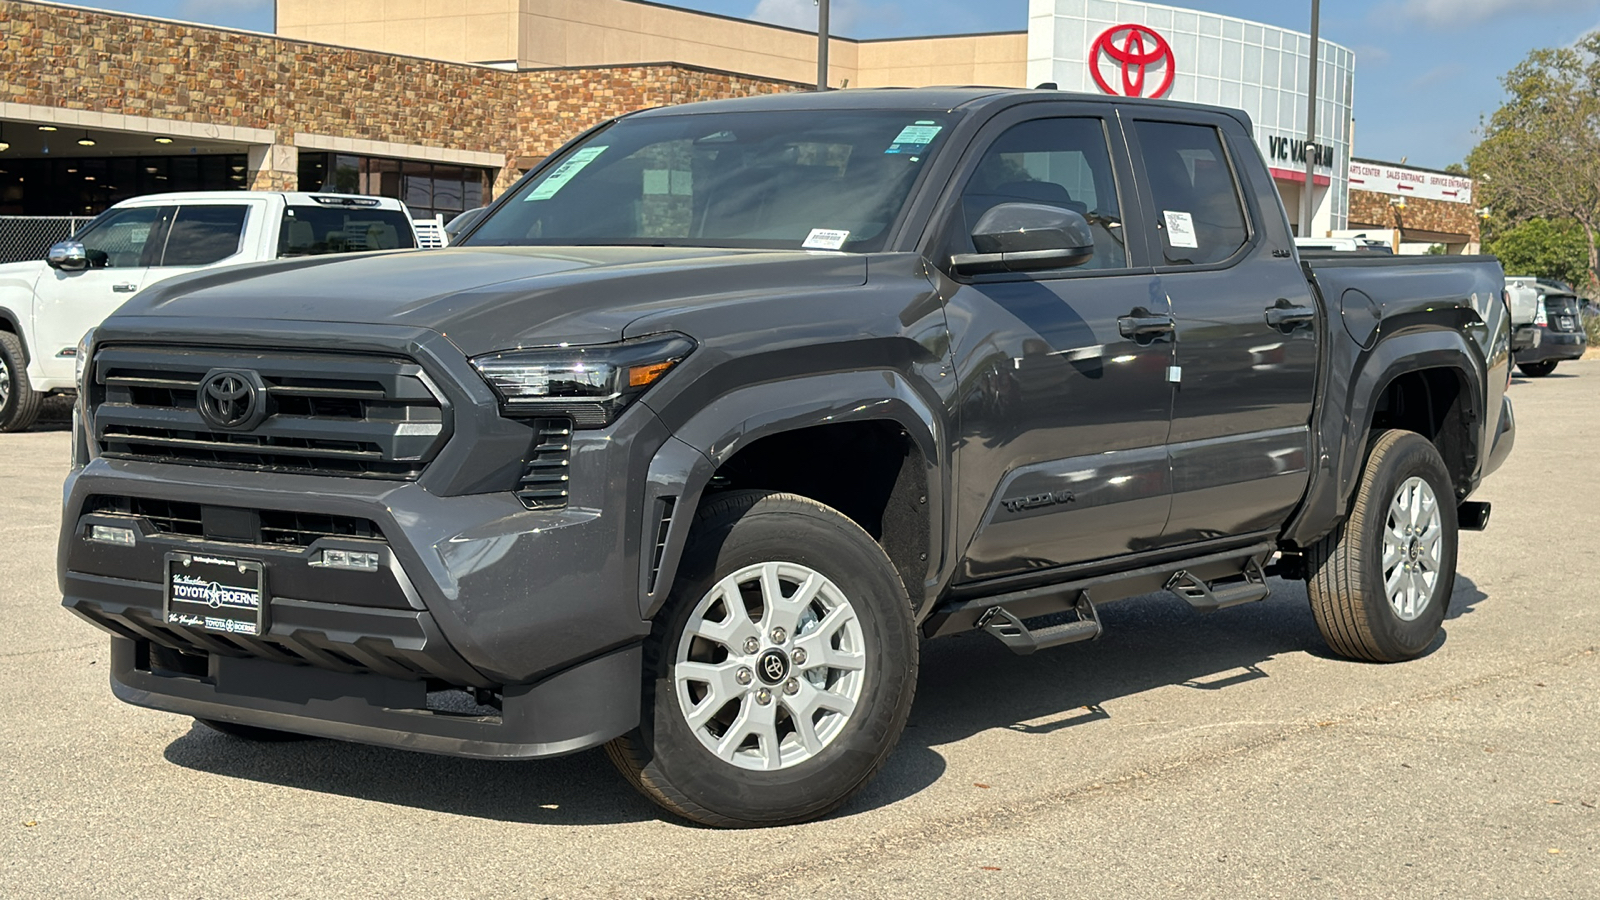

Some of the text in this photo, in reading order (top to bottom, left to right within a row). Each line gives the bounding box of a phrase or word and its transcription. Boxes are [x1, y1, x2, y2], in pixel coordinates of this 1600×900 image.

[1269, 135, 1288, 160] VIC
[1349, 164, 1381, 178] ARTS CENTER
[1386, 169, 1425, 184] SALES ENTRANCE
[1429, 176, 1471, 190] SERVICE ENTRANCE
[1001, 488, 1076, 513] TACOMA
[173, 584, 210, 599] TOYOTA
[221, 590, 259, 606] BOERNE
[205, 619, 226, 629] TOYOTA
